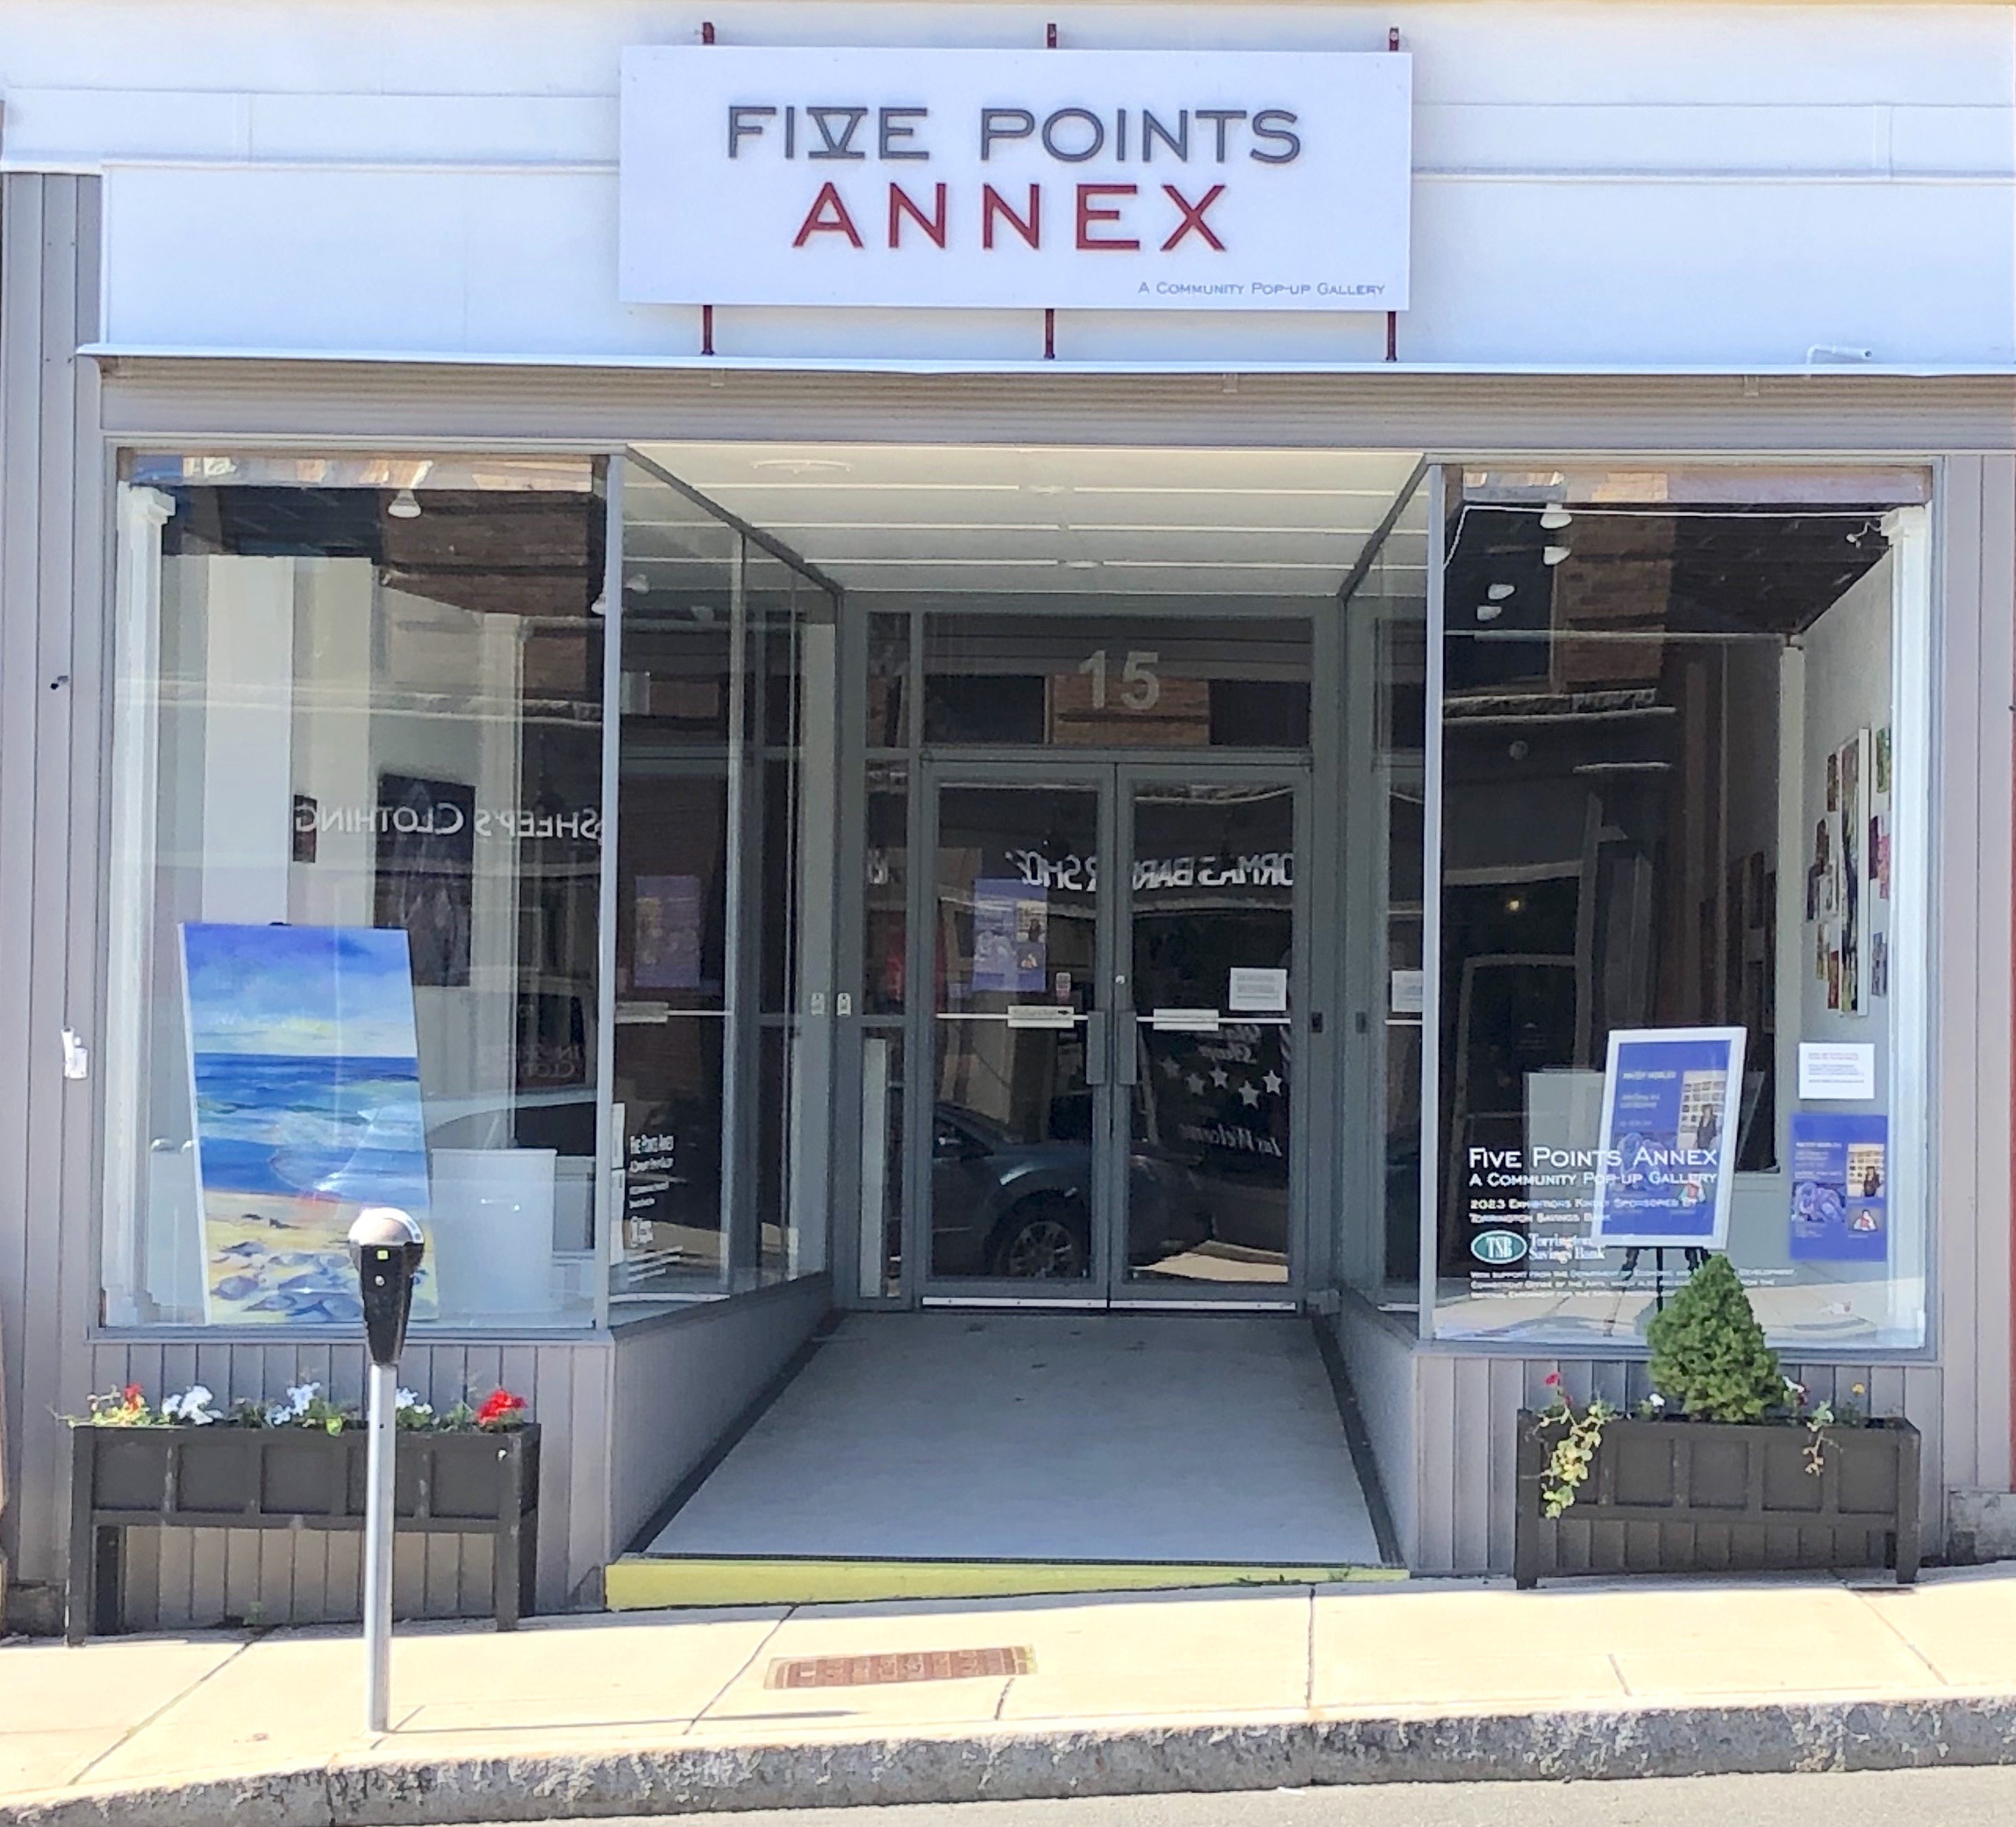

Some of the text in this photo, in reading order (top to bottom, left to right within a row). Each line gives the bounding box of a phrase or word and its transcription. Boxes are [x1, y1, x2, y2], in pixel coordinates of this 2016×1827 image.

[728, 106, 1302, 163] FIVE POINTS
[791, 182, 1226, 251] ANNEX
[1138, 282, 1150, 295] A
[1078, 650, 1160, 710] 15
[1469, 1173, 1483, 1186] A
[1486, 1236, 1513, 1258] TSB
